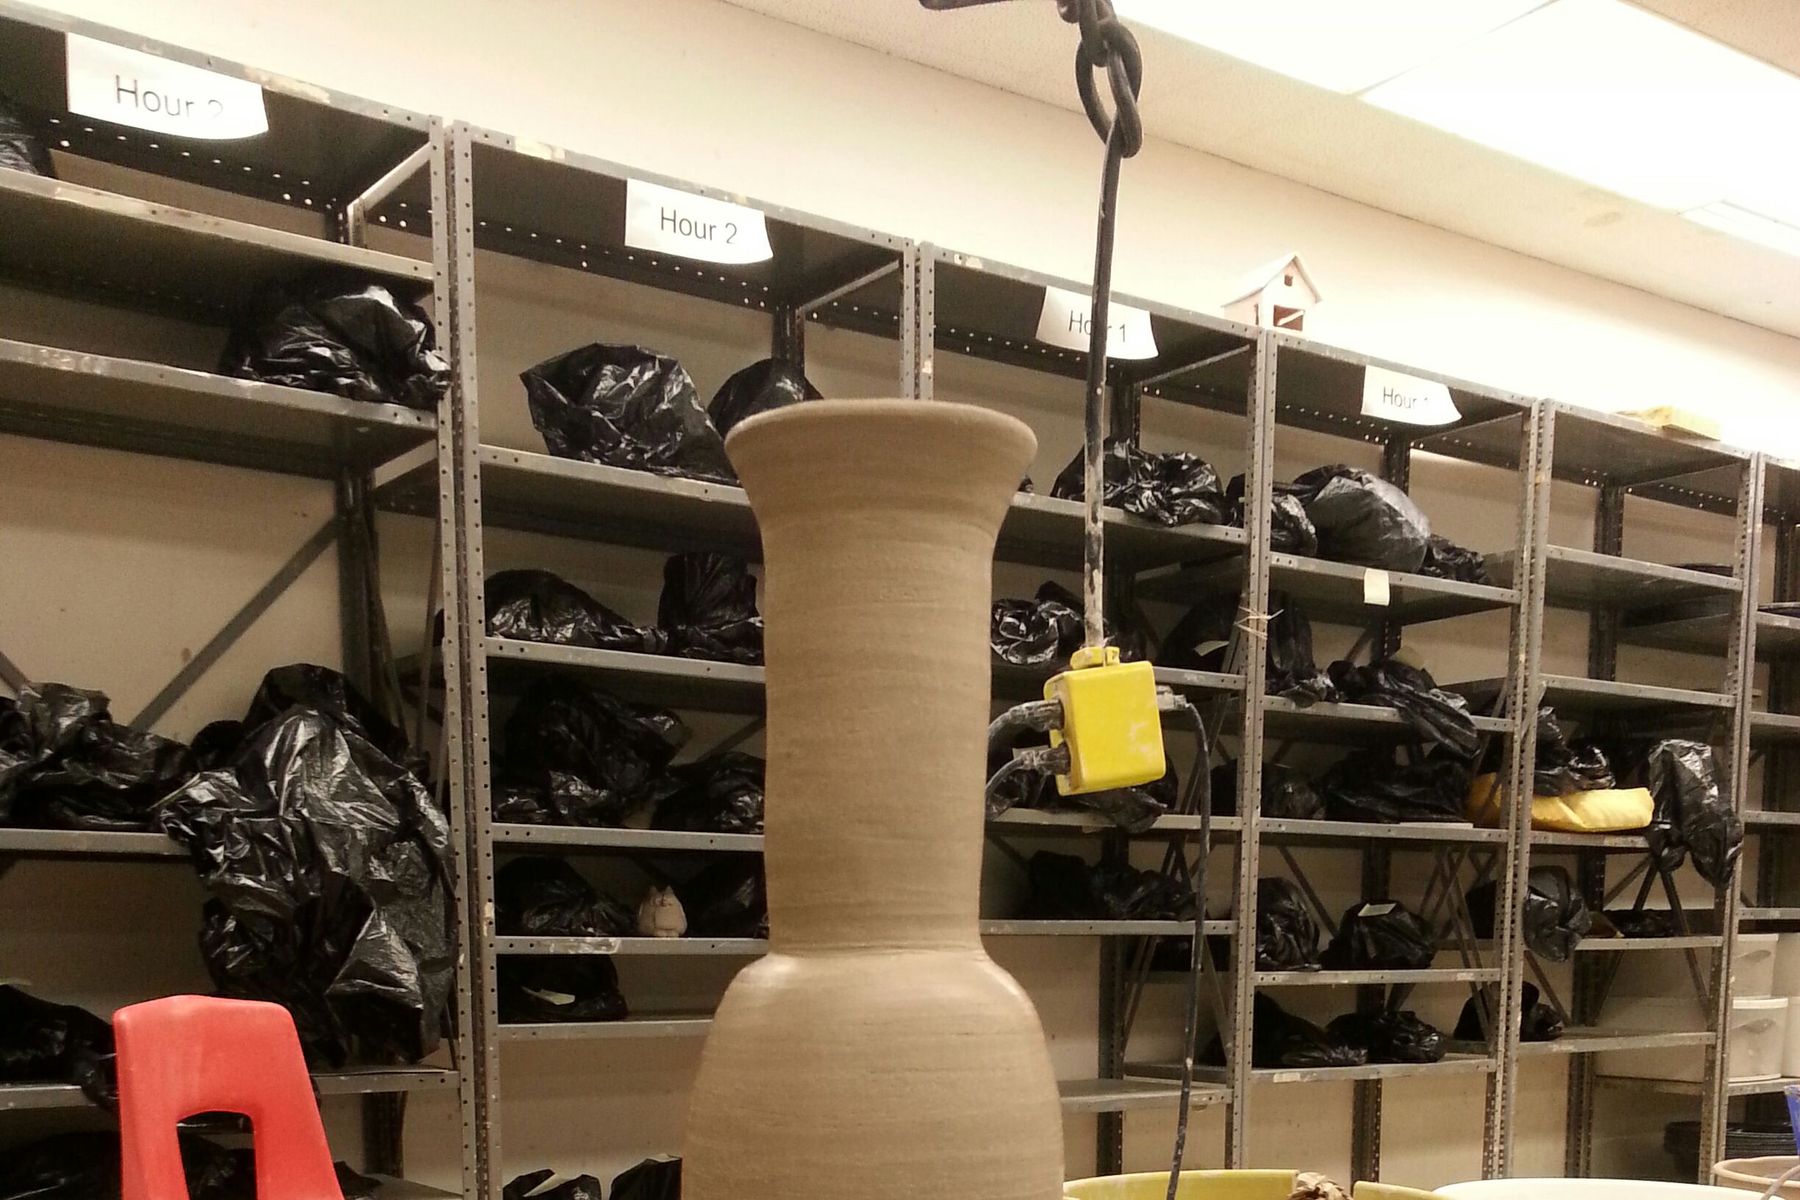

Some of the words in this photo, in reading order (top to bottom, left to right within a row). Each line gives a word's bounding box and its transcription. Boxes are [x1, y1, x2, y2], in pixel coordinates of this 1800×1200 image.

[115, 74, 195, 117] Hour
[660, 206, 716, 241] Hour
[725, 222, 738, 245] 2
[1069, 310, 1112, 336] Ho
[1119, 323, 1126, 343] 1
[1383, 386, 1417, 409] Hour
